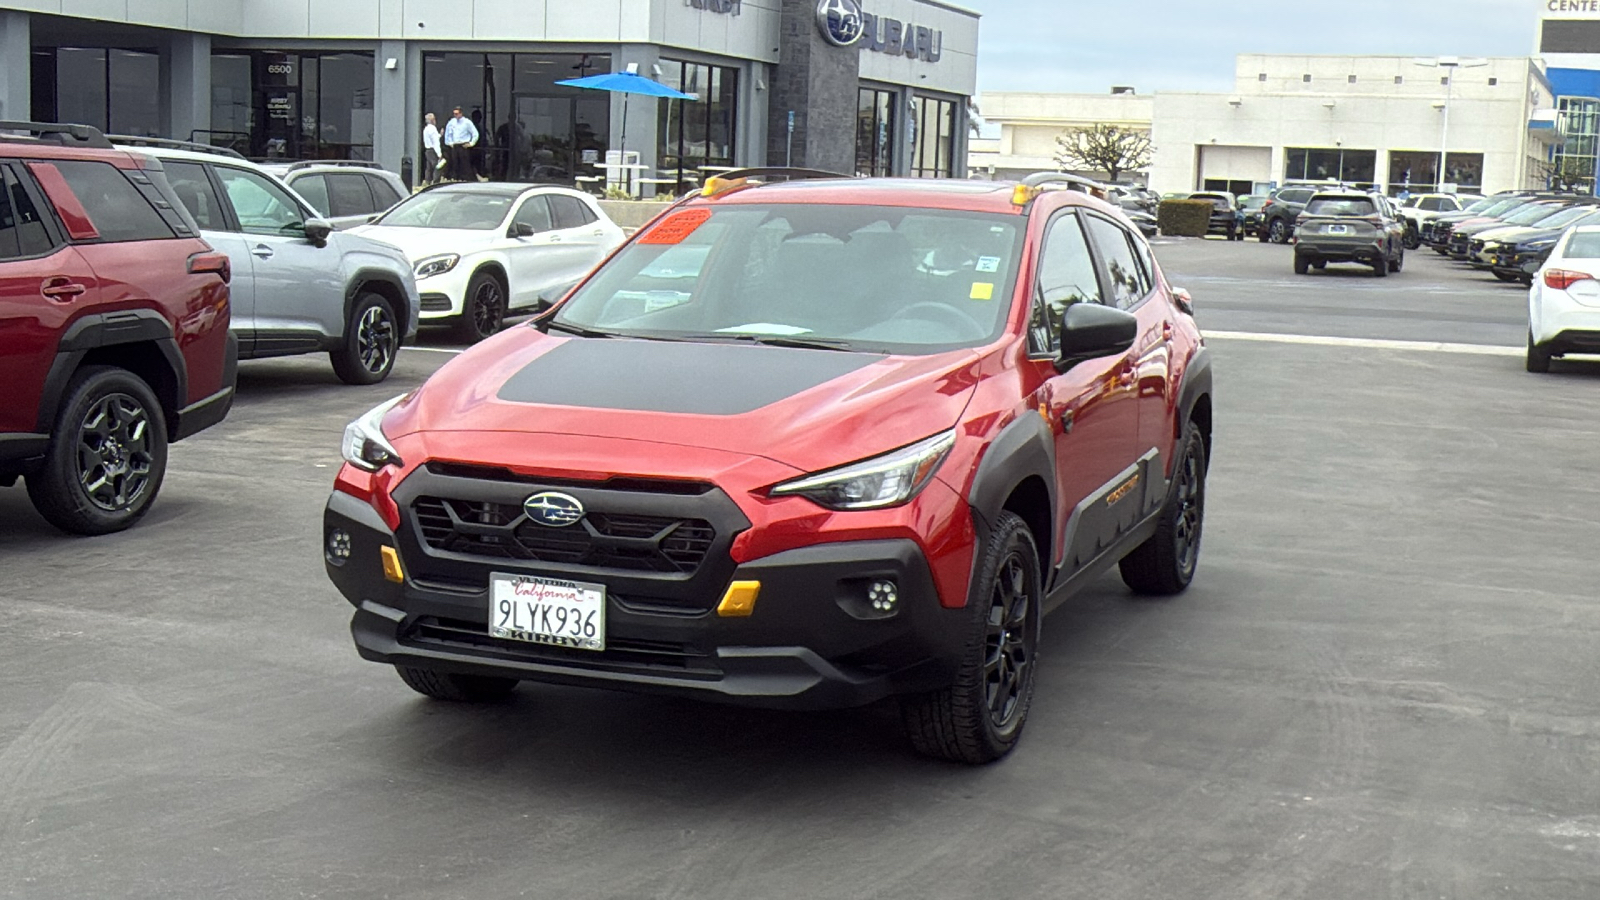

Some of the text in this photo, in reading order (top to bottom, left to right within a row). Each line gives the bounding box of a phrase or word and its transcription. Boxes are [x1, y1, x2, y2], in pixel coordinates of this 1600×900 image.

[1547, 0, 1600, 12] CENTE
[858, 12, 942, 62] SUBARU
[268, 65, 292, 74] 6500
[514, 581, 584, 602] California
[499, 599, 597, 638] 9LYK936
[511, 629, 583, 647] KIRBY
